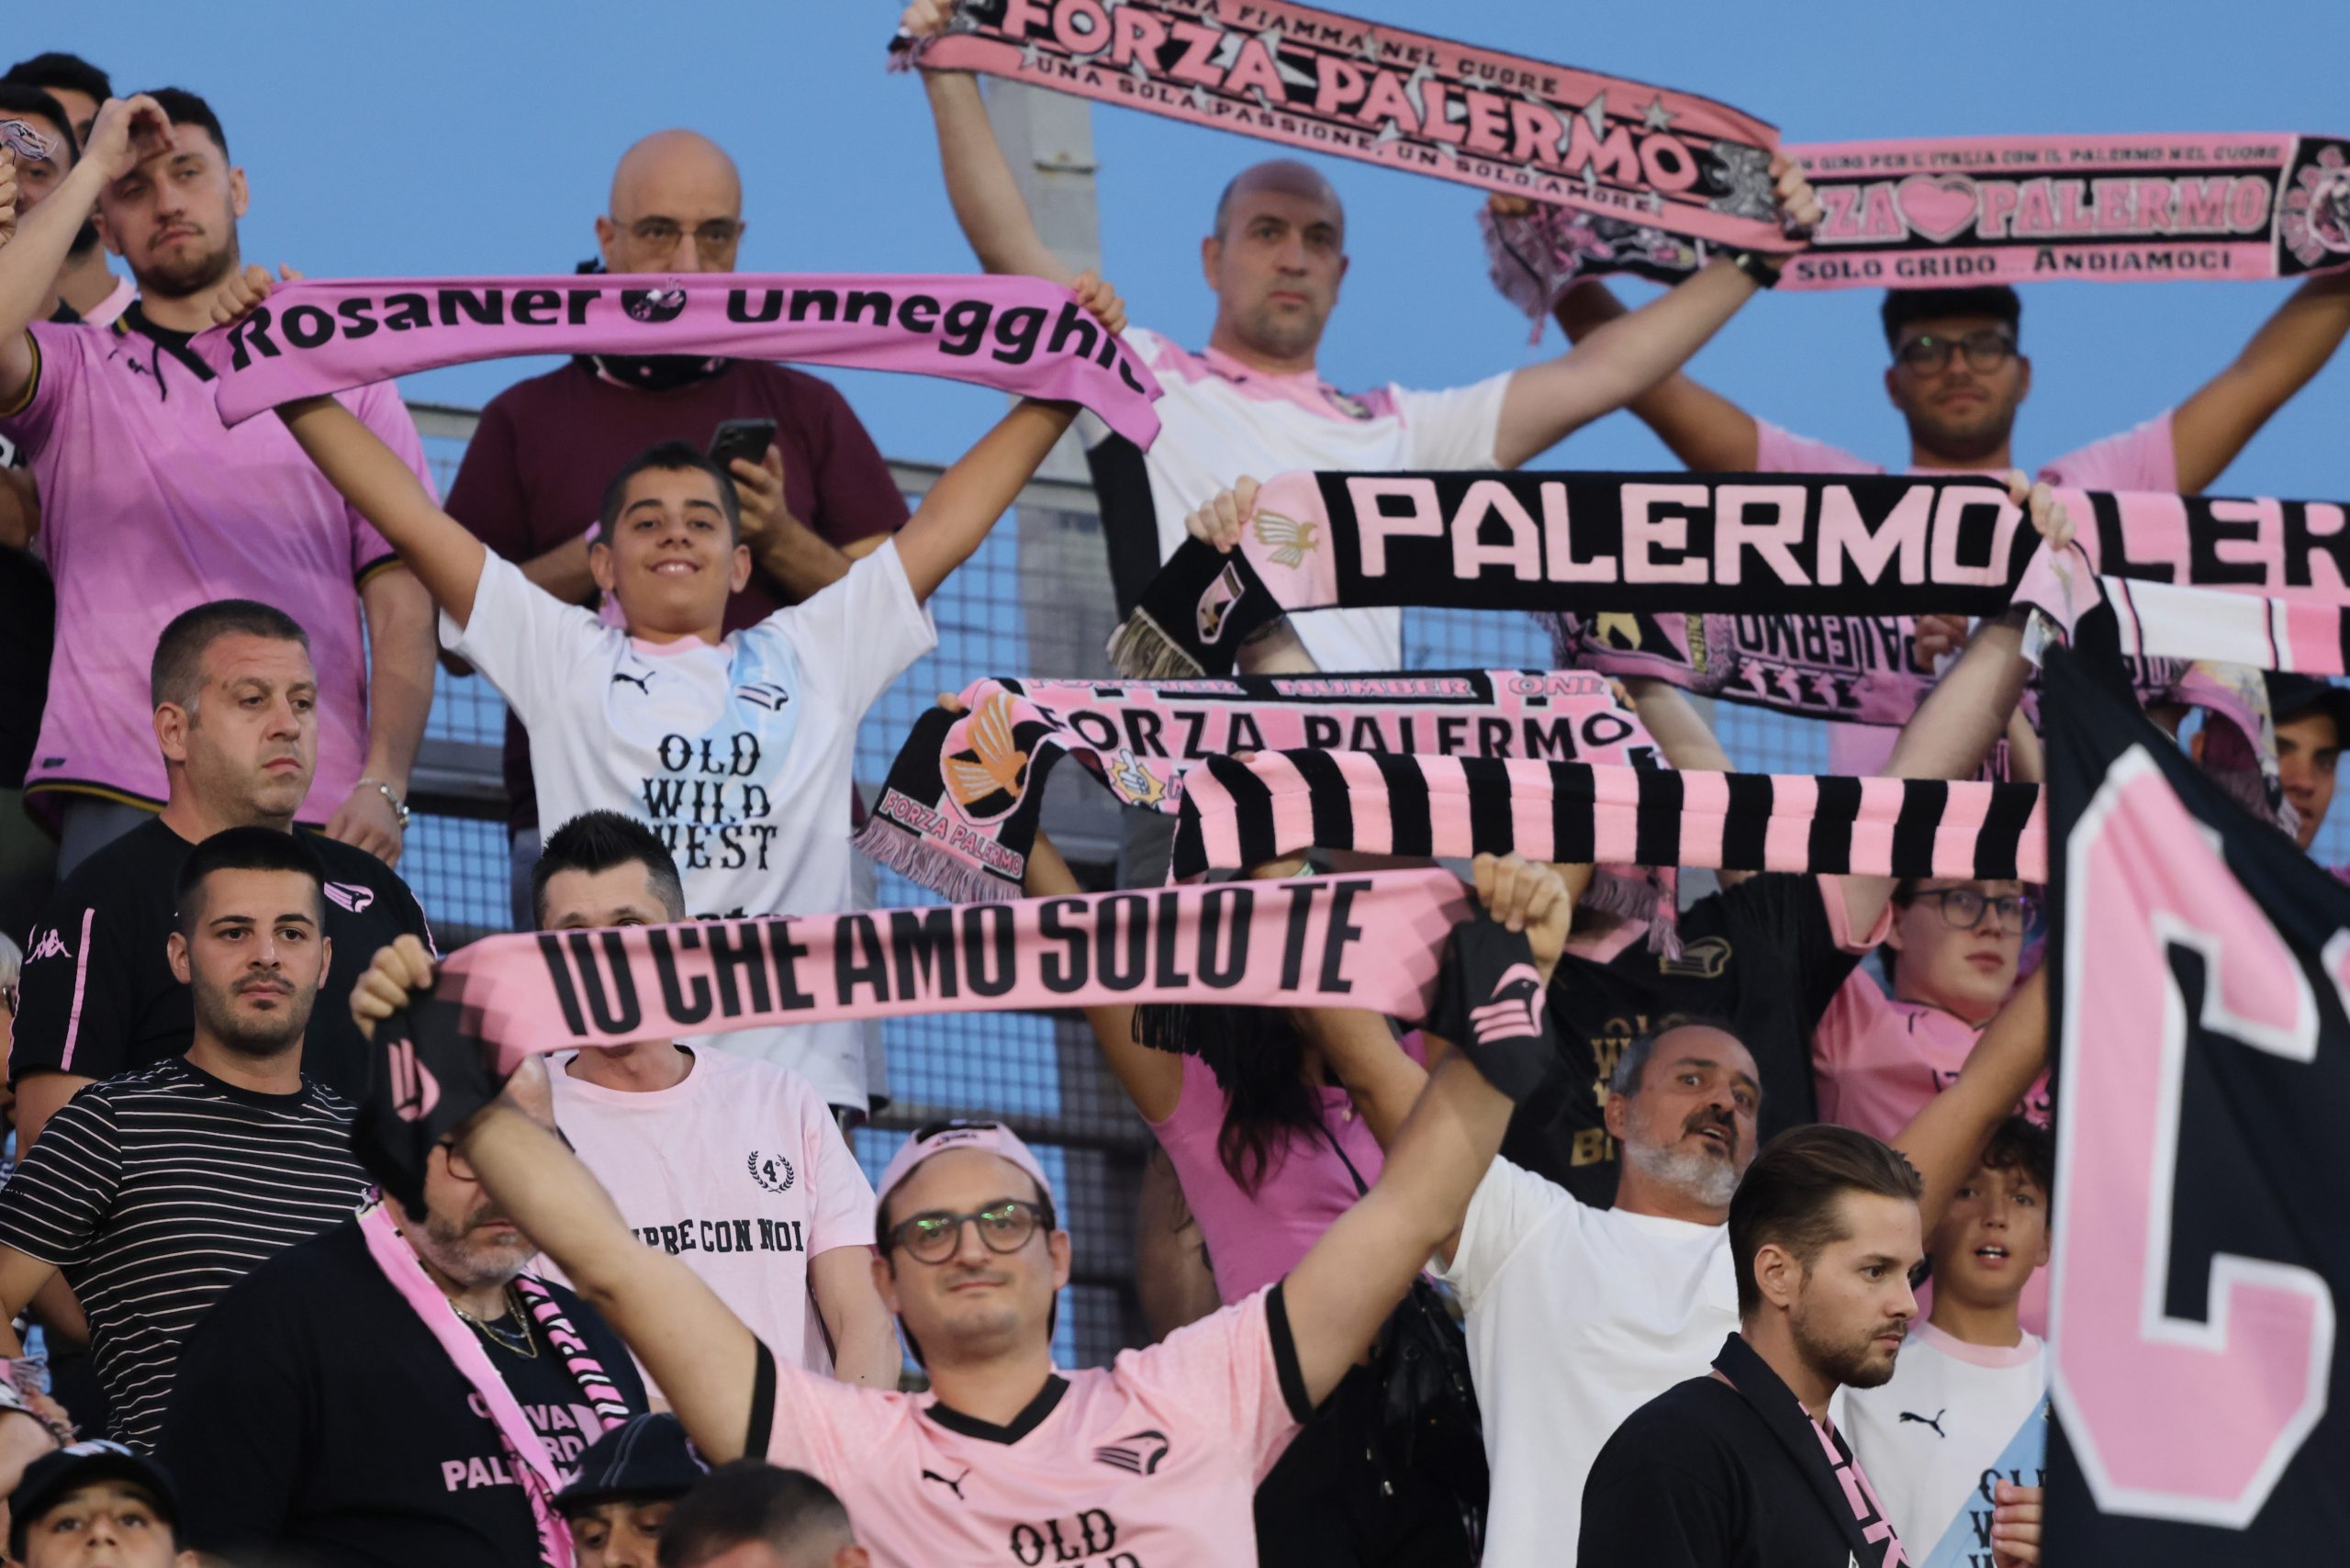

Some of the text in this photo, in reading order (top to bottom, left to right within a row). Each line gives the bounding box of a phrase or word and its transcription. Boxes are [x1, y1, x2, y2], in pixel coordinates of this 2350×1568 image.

[1239, 6, 1364, 50] FIAMMA
[1382, 40, 1440, 70] NEL
[1458, 58, 1559, 95] CUORE
[1002, 0, 1699, 195] FORZA PALERMO
[1037, 56, 1103, 87] UNA
[1117, 76, 1195, 109] SOLA
[1396, 144, 1438, 166] UN
[1456, 159, 1530, 186] SOLO
[1545, 181, 1653, 213] AMORE
[1870, 153, 1908, 167] PER
[2001, 149, 2037, 163] CON
[2045, 148, 2062, 163] IL
[2070, 146, 2163, 162] PALERMO
[2169, 145, 2206, 162] NEL
[2213, 144, 2279, 161] CUORE
[1977, 176, 2271, 239] PALERMO
[1796, 258, 1883, 280] SOLO
[1346, 476, 2022, 586] PALERMO
[1271, 675, 1605, 698] NUMBER ONE
[658, 731, 762, 777] OLD
[641, 778, 772, 824] WILD
[881, 791, 1024, 879] FORZA PALERMO
[648, 921, 814, 1025] CHE
[834, 905, 1015, 1005] AMO
[1039, 887, 1255, 993] SOLO
[1278, 879, 1372, 993] TE
[699, 1219, 754, 1253] CON
[757, 1218, 805, 1253] NOI
[1010, 1508, 1116, 1567] OLD
